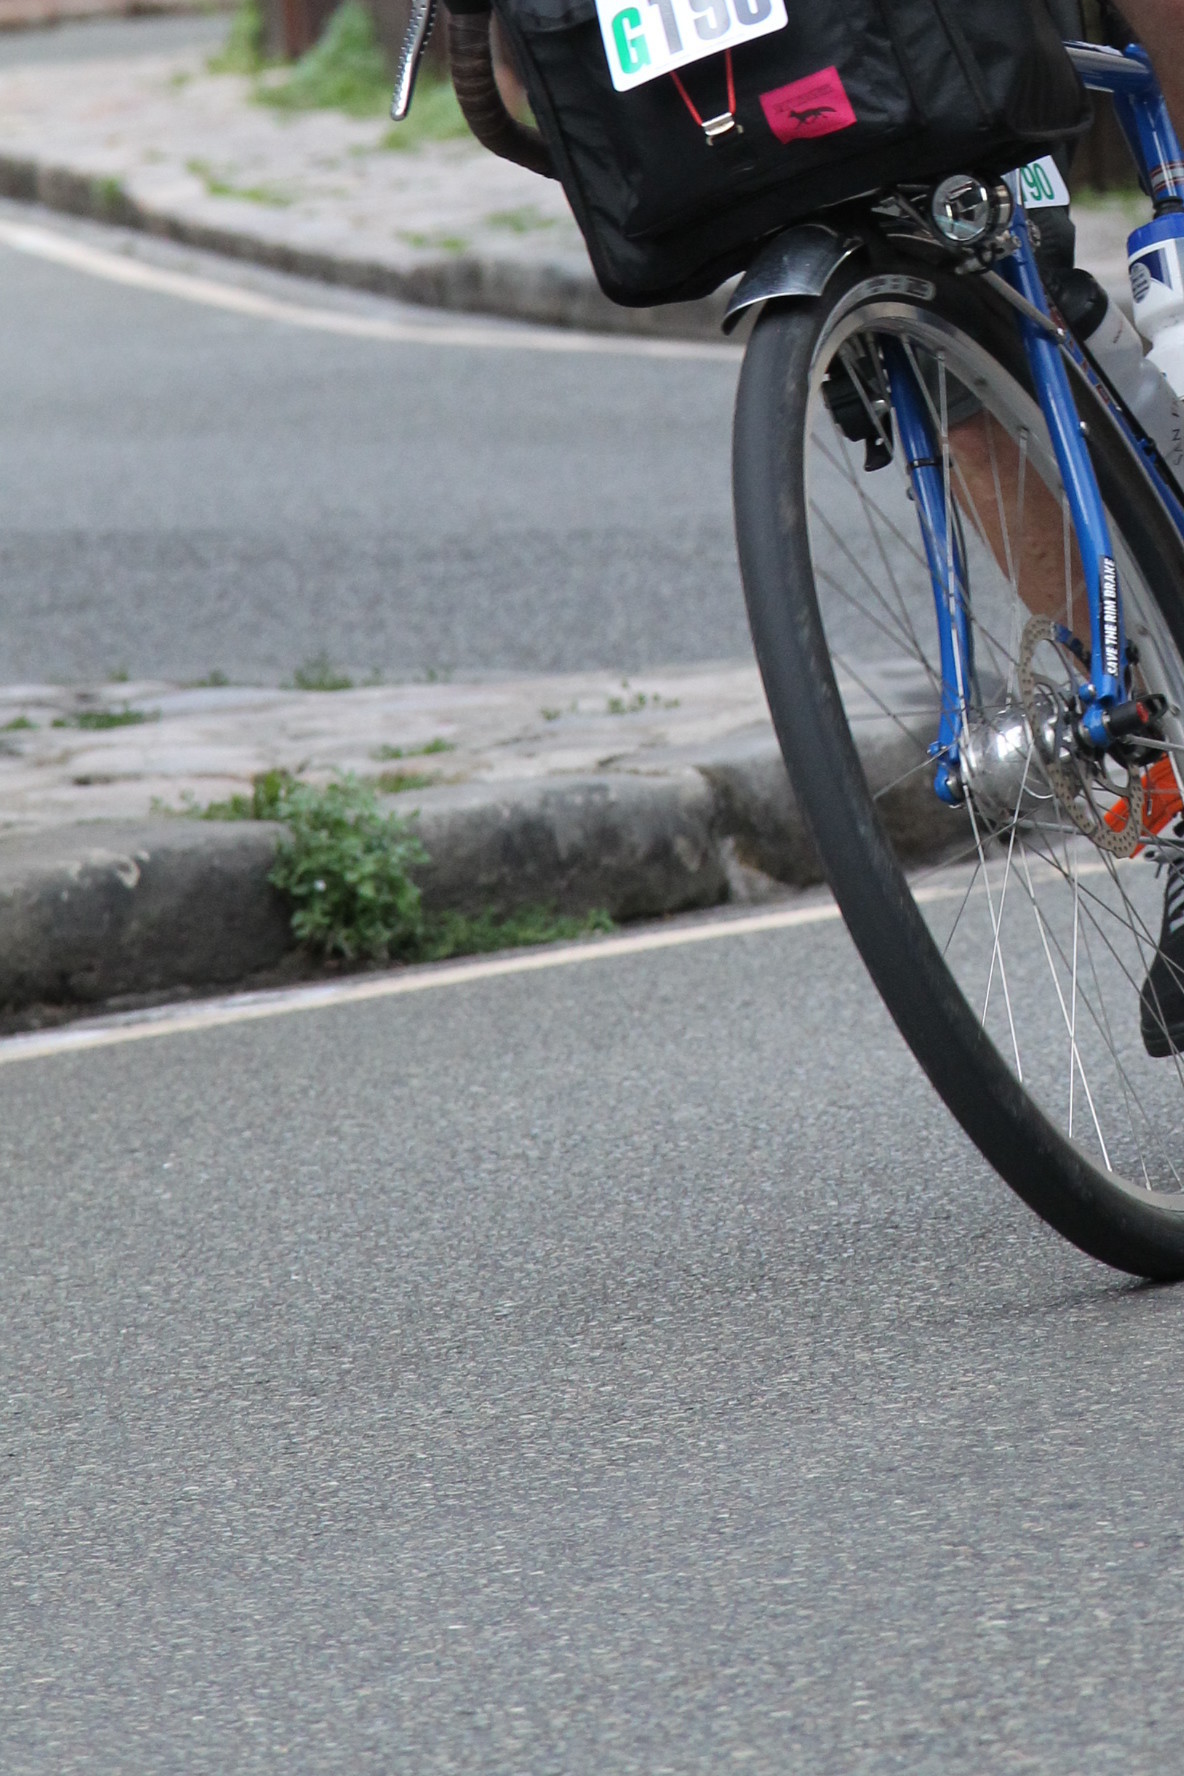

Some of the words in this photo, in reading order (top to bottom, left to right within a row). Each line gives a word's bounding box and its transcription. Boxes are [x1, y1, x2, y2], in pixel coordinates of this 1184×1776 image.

[1103, 558, 1117, 598] BRAKE
[1104, 601, 1117, 622] RIM
[1104, 623, 1118, 647] THE
[1107, 649, 1119, 676] SAVE
